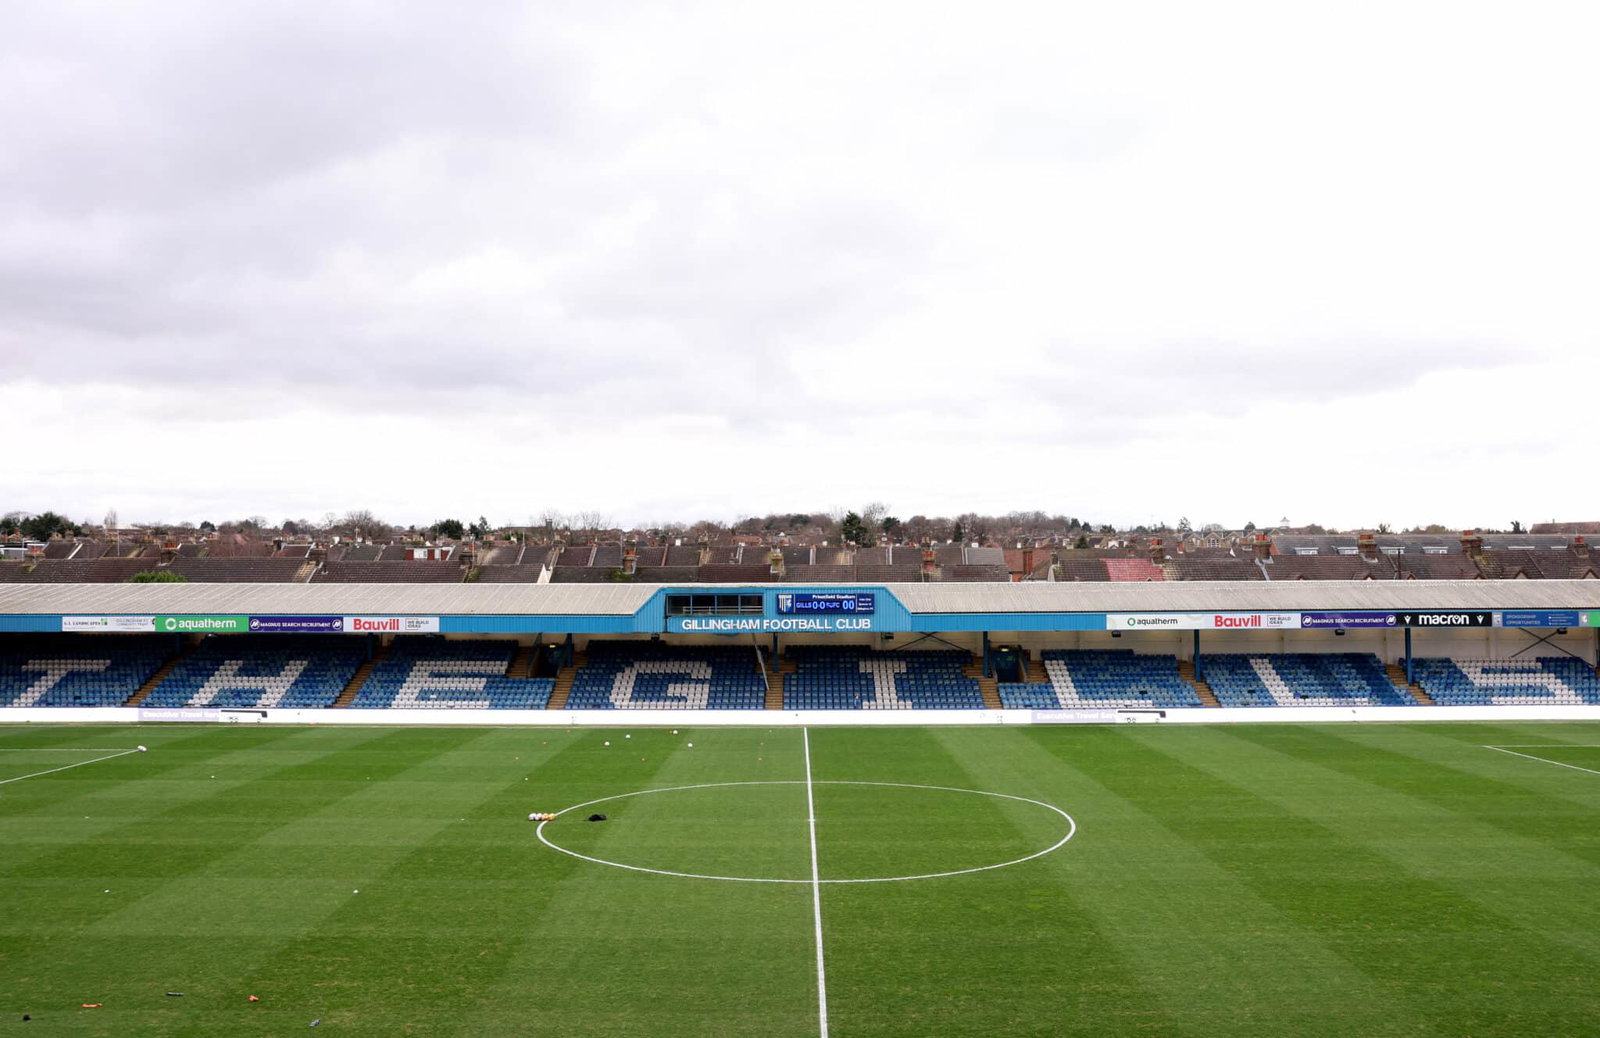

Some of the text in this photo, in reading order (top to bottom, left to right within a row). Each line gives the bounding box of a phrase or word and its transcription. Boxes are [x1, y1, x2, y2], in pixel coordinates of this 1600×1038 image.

[842, 600, 855, 610] 00
[178, 618, 237, 630] aquatherm
[353, 618, 400, 630] Bauvill
[682, 618, 871, 630] GILLINGHAM FOOTBALL CLUB
[1136, 618, 1178, 626] aquatherm
[1214, 615, 1261, 627] Bauvill
[1418, 614, 1469, 625] macron
